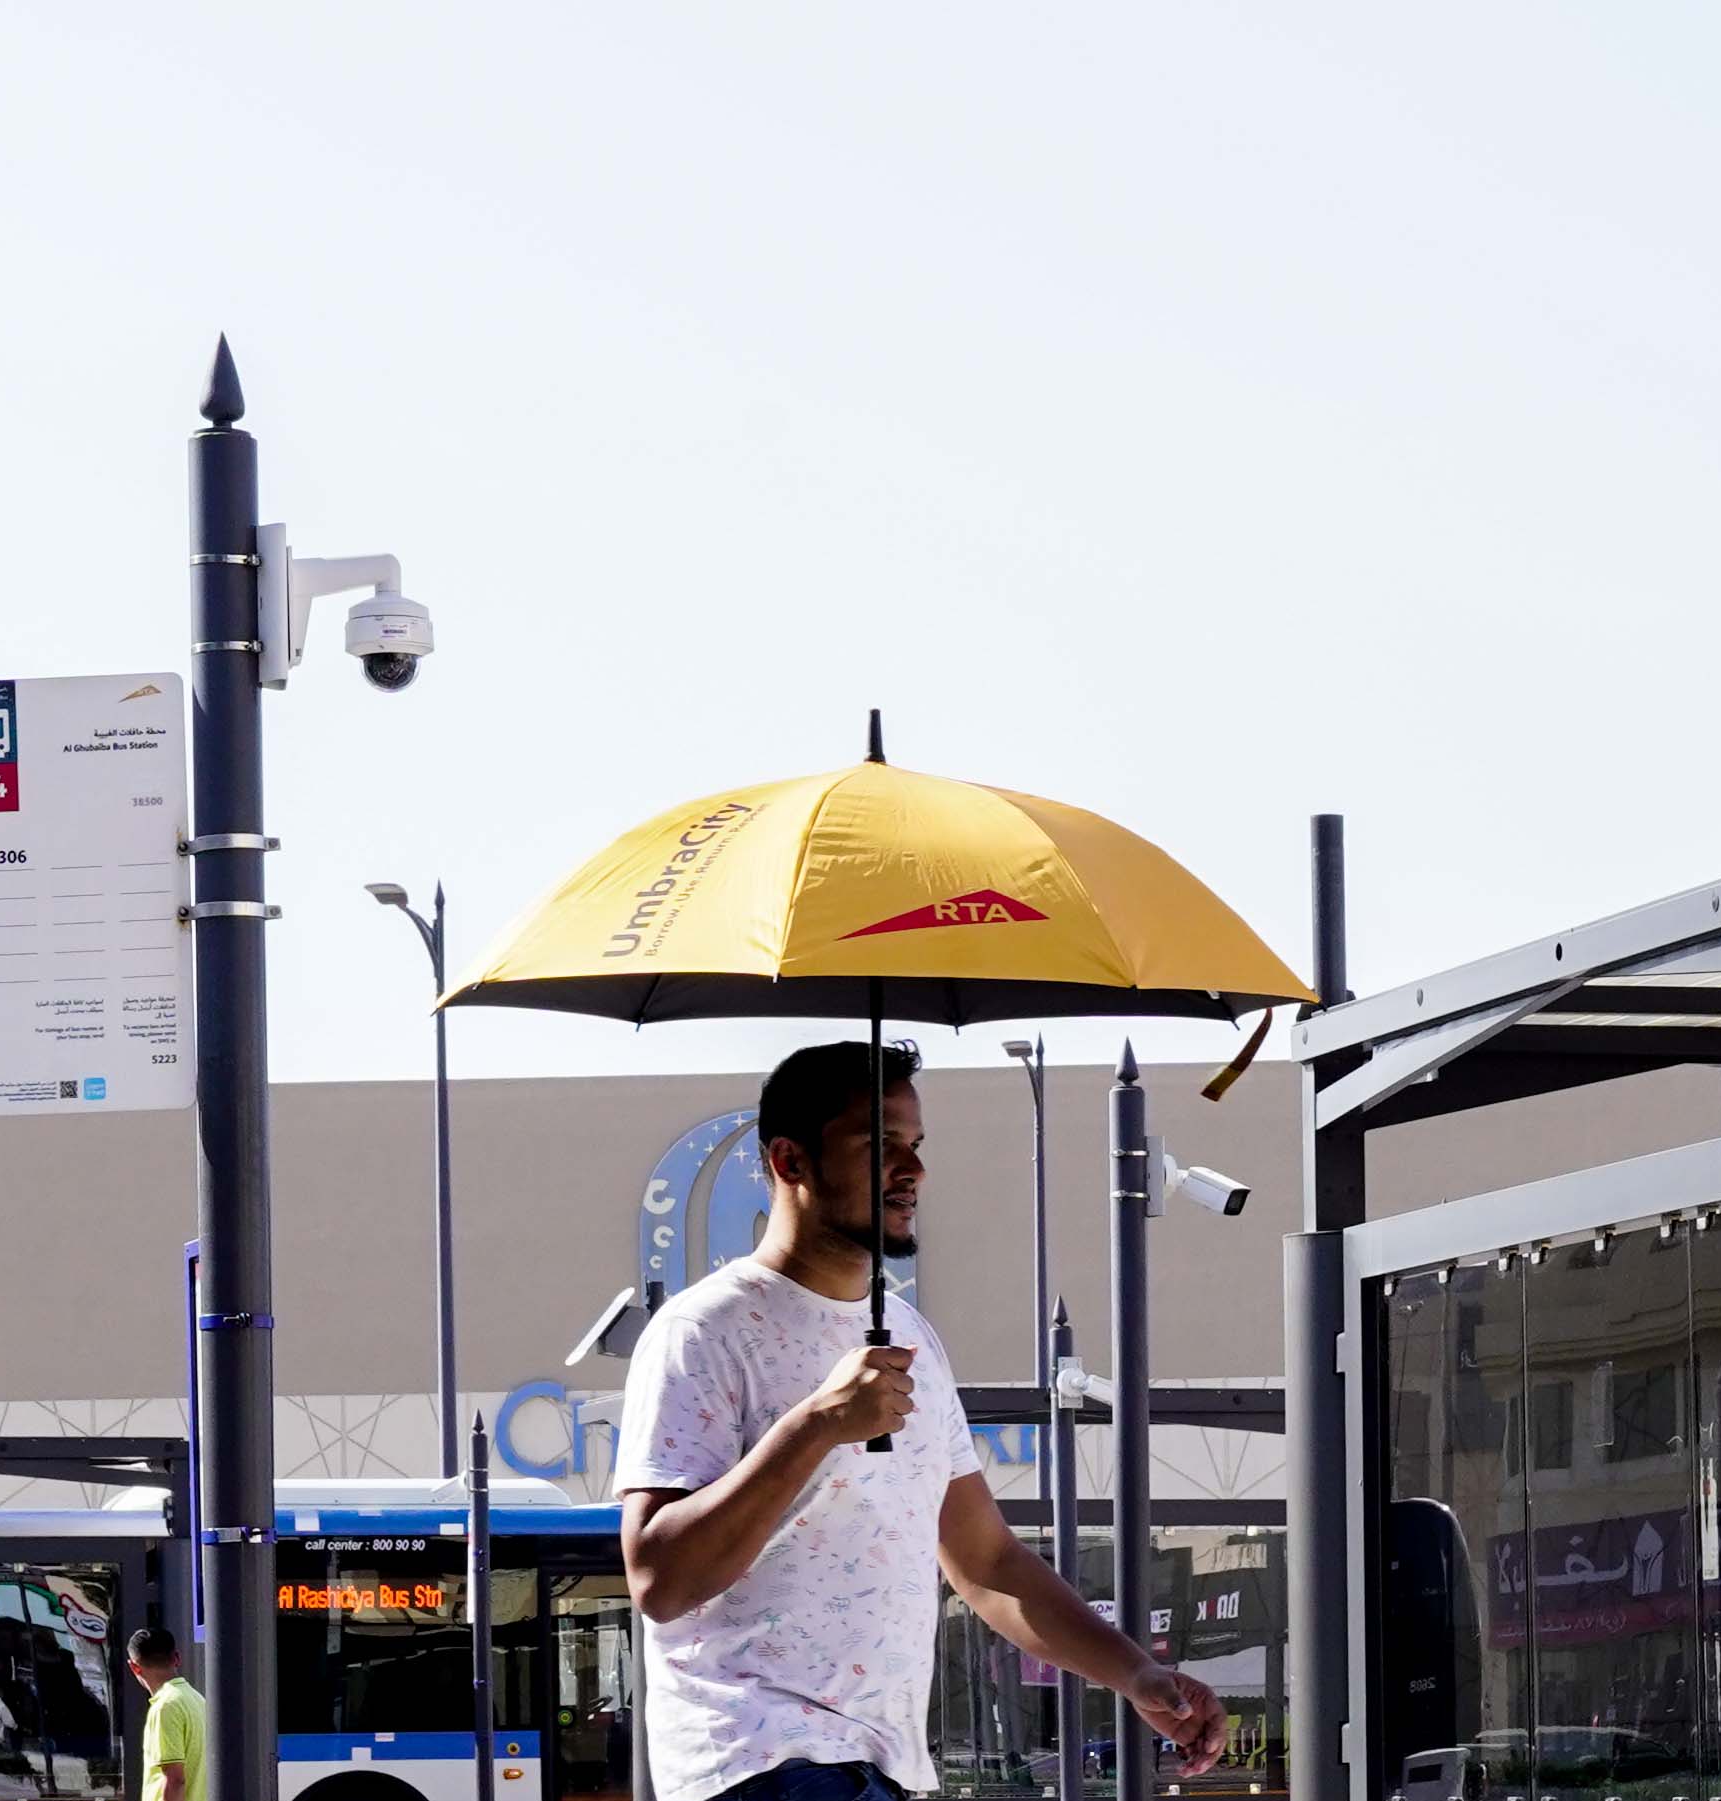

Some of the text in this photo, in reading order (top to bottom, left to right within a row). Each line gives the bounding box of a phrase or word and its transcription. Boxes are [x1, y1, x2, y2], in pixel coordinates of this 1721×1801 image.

[112, 742, 128, 751] Bus
[129, 741, 158, 750] Station
[602, 803, 752, 957] UmbraCity
[934, 902, 1015, 922] RTA
[151, 1054, 177, 1064] 5223
[305, 1538, 325, 1550] call
[328, 1539, 363, 1550] center
[373, 1539, 393, 1551] 800
[395, 1540, 409, 1551] 90
[411, 1540, 425, 1551] 90
[298, 1586, 375, 1614] Rashidiya
[379, 1585, 410, 1608] Bus
[414, 1584, 442, 1608] Stn
